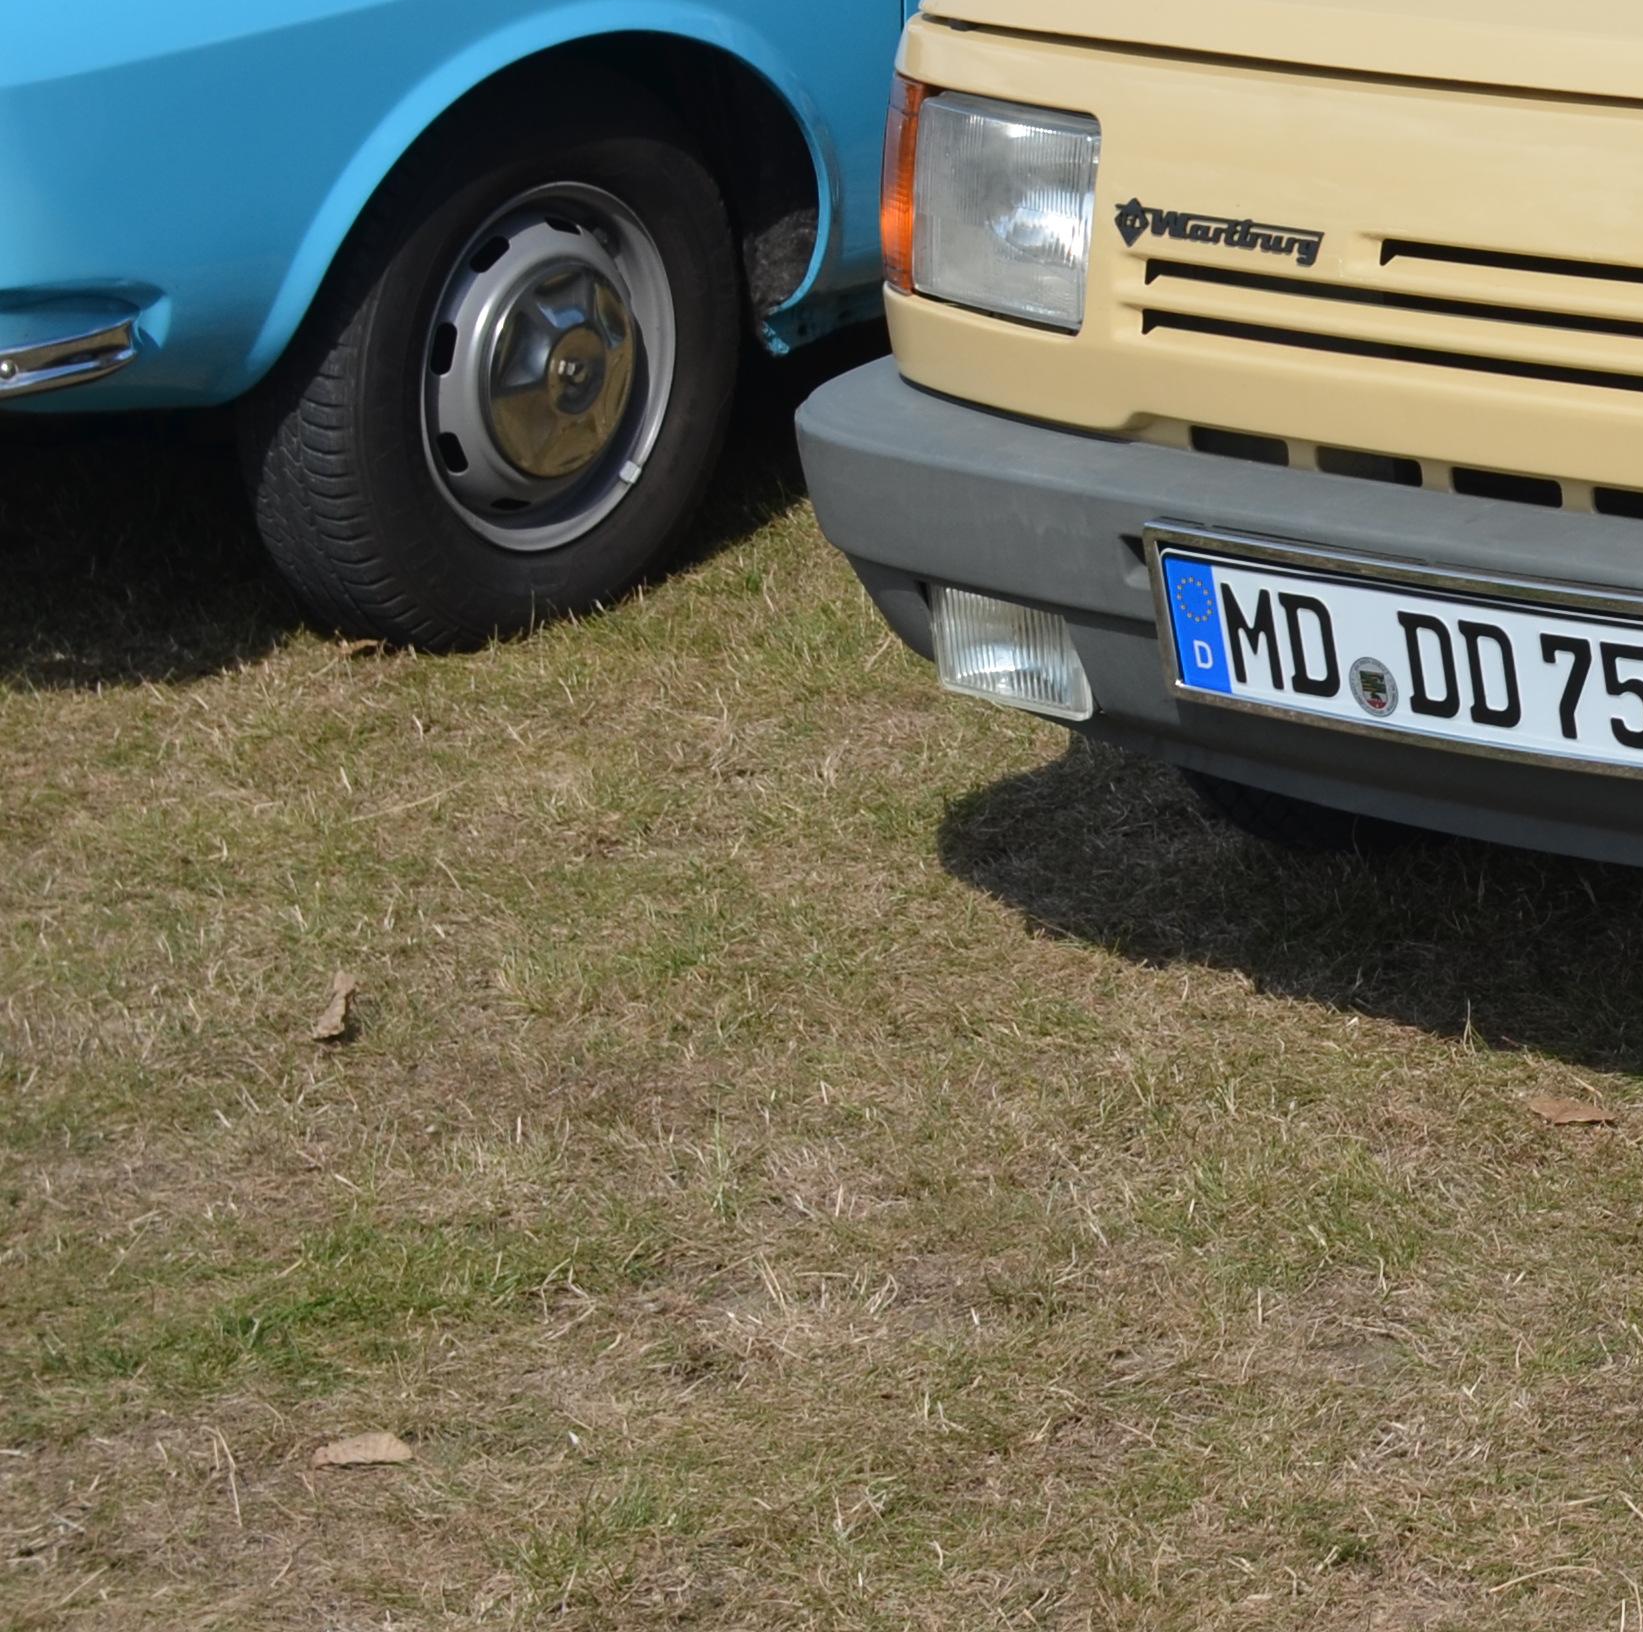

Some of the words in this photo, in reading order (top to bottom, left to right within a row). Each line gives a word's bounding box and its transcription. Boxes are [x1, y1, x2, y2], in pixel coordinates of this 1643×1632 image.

[1150, 207, 1325, 267] Wartburg
[1193, 639, 1214, 669] D
[1220, 581, 1341, 698] MD
[1397, 609, 1522, 729] DD
